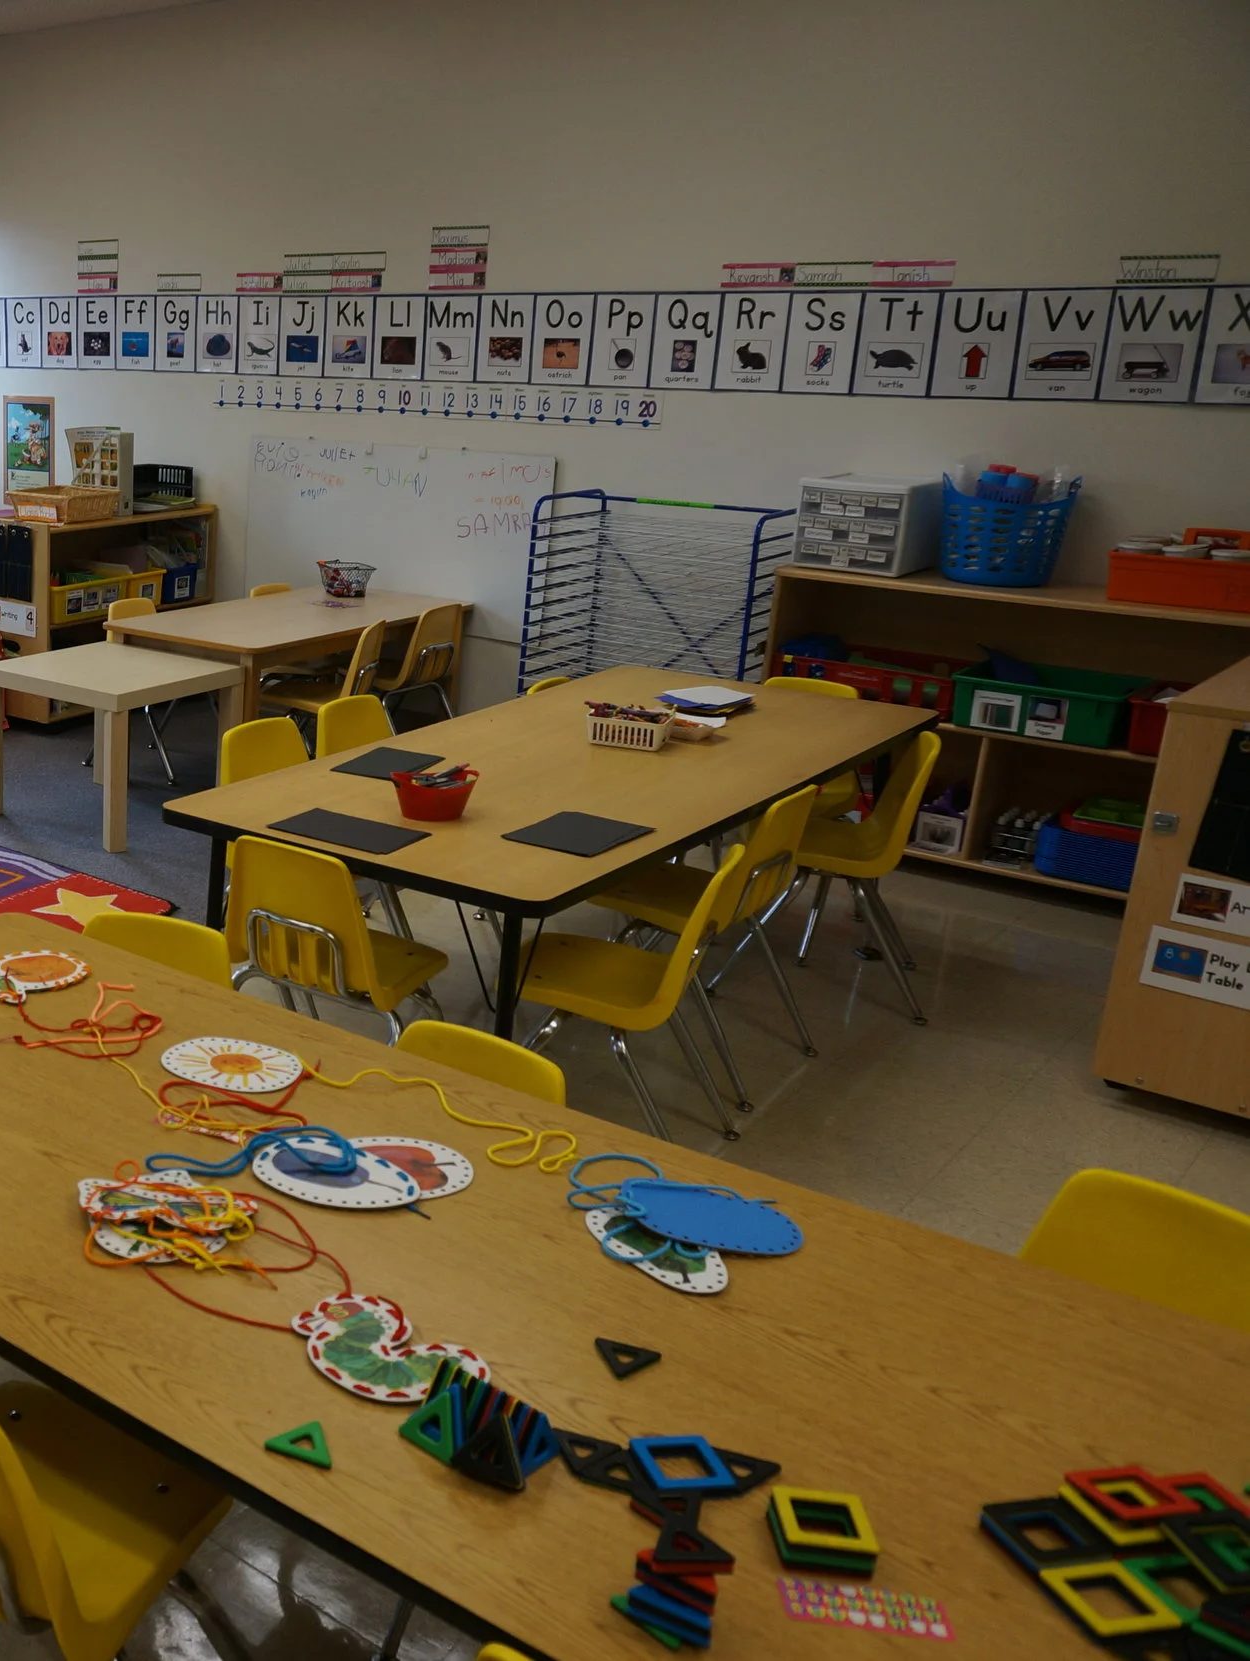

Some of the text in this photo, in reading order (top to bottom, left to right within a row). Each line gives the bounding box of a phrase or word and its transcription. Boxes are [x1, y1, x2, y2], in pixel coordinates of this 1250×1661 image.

[431, 230, 468, 243] Maximus
[286, 258, 312, 271] Juliet
[437, 252, 474, 265] Madison
[796, 267, 842, 282] Samrah
[1120, 259, 1176, 279] Winston
[446, 274, 464, 286] Mia
[13, 302, 35, 324] Cc
[49, 301, 70, 324] Dd
[86, 300, 108, 324] Ee
[124, 300, 148, 324] Ff
[164, 300, 190, 331] Gg
[206, 300, 232, 325] Hh
[253, 300, 270, 326] Ii
[292, 301, 315, 334] Jj
[336, 301, 365, 328] Kk
[390, 301, 410, 327] Ll
[429, 301, 474, 328] Mm
[491, 299, 524, 328] Nn
[546, 299, 583, 329] Oo
[608, 299, 643, 336] Pp
[668, 299, 713, 338] Qq
[737, 297, 776, 330] Rr
[805, 297, 846, 331] Ss
[879, 297, 924, 332] Tt
[954, 297, 1007, 333] Uu
[1043, 295, 1095, 332] Vv
[1118, 294, 1203, 332] Ww
[497, 369, 512, 377] nuts
[547, 370, 573, 379] ostrich
[613, 374, 627, 382] pan
[665, 375, 699, 384] quarters
[736, 376, 761, 384] rabbit
[806, 378, 830, 387] socks
[877, 380, 904, 389] turtle
[1129, 387, 1162, 396] wagon
[220, 385, 657, 418] 1 2 3 4 5 6 7 8 9 10 11 12 13 14 15 16 17 18 19 20
[26, 611, 33, 624] 4
[1231, 902, 1250, 914] Ar
[1210, 954, 1240, 972] Play
[1206, 972, 1244, 990] Table
